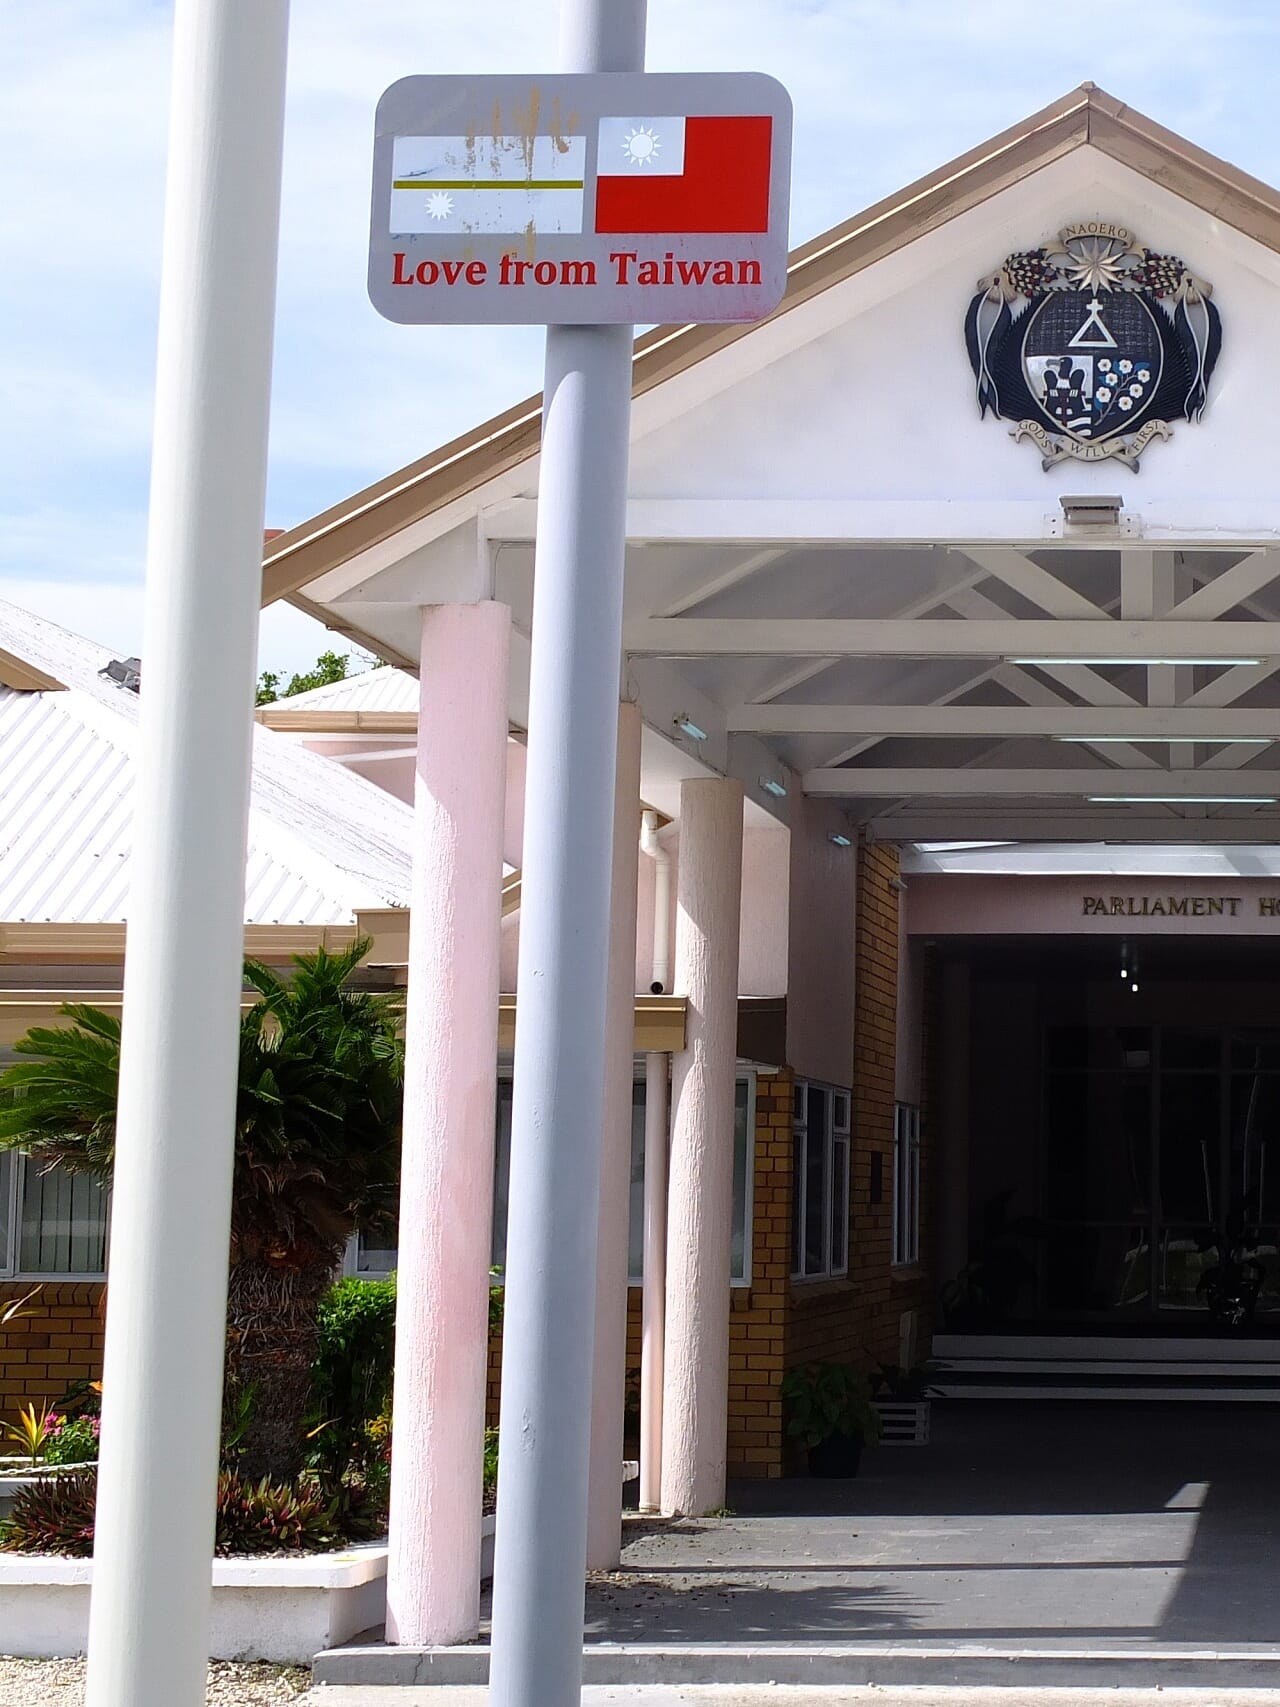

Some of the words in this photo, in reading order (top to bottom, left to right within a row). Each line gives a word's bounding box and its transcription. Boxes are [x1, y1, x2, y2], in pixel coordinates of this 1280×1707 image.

[1066, 223, 1128, 239] NAOERO
[392, 253, 487, 286] Love
[498, 254, 597, 286] from
[609, 253, 762, 285] Taiwan
[1070, 442, 1110, 457] WILL
[1132, 421, 1160, 451] FIRST
[1082, 897, 1241, 916] PARLIAMENT
